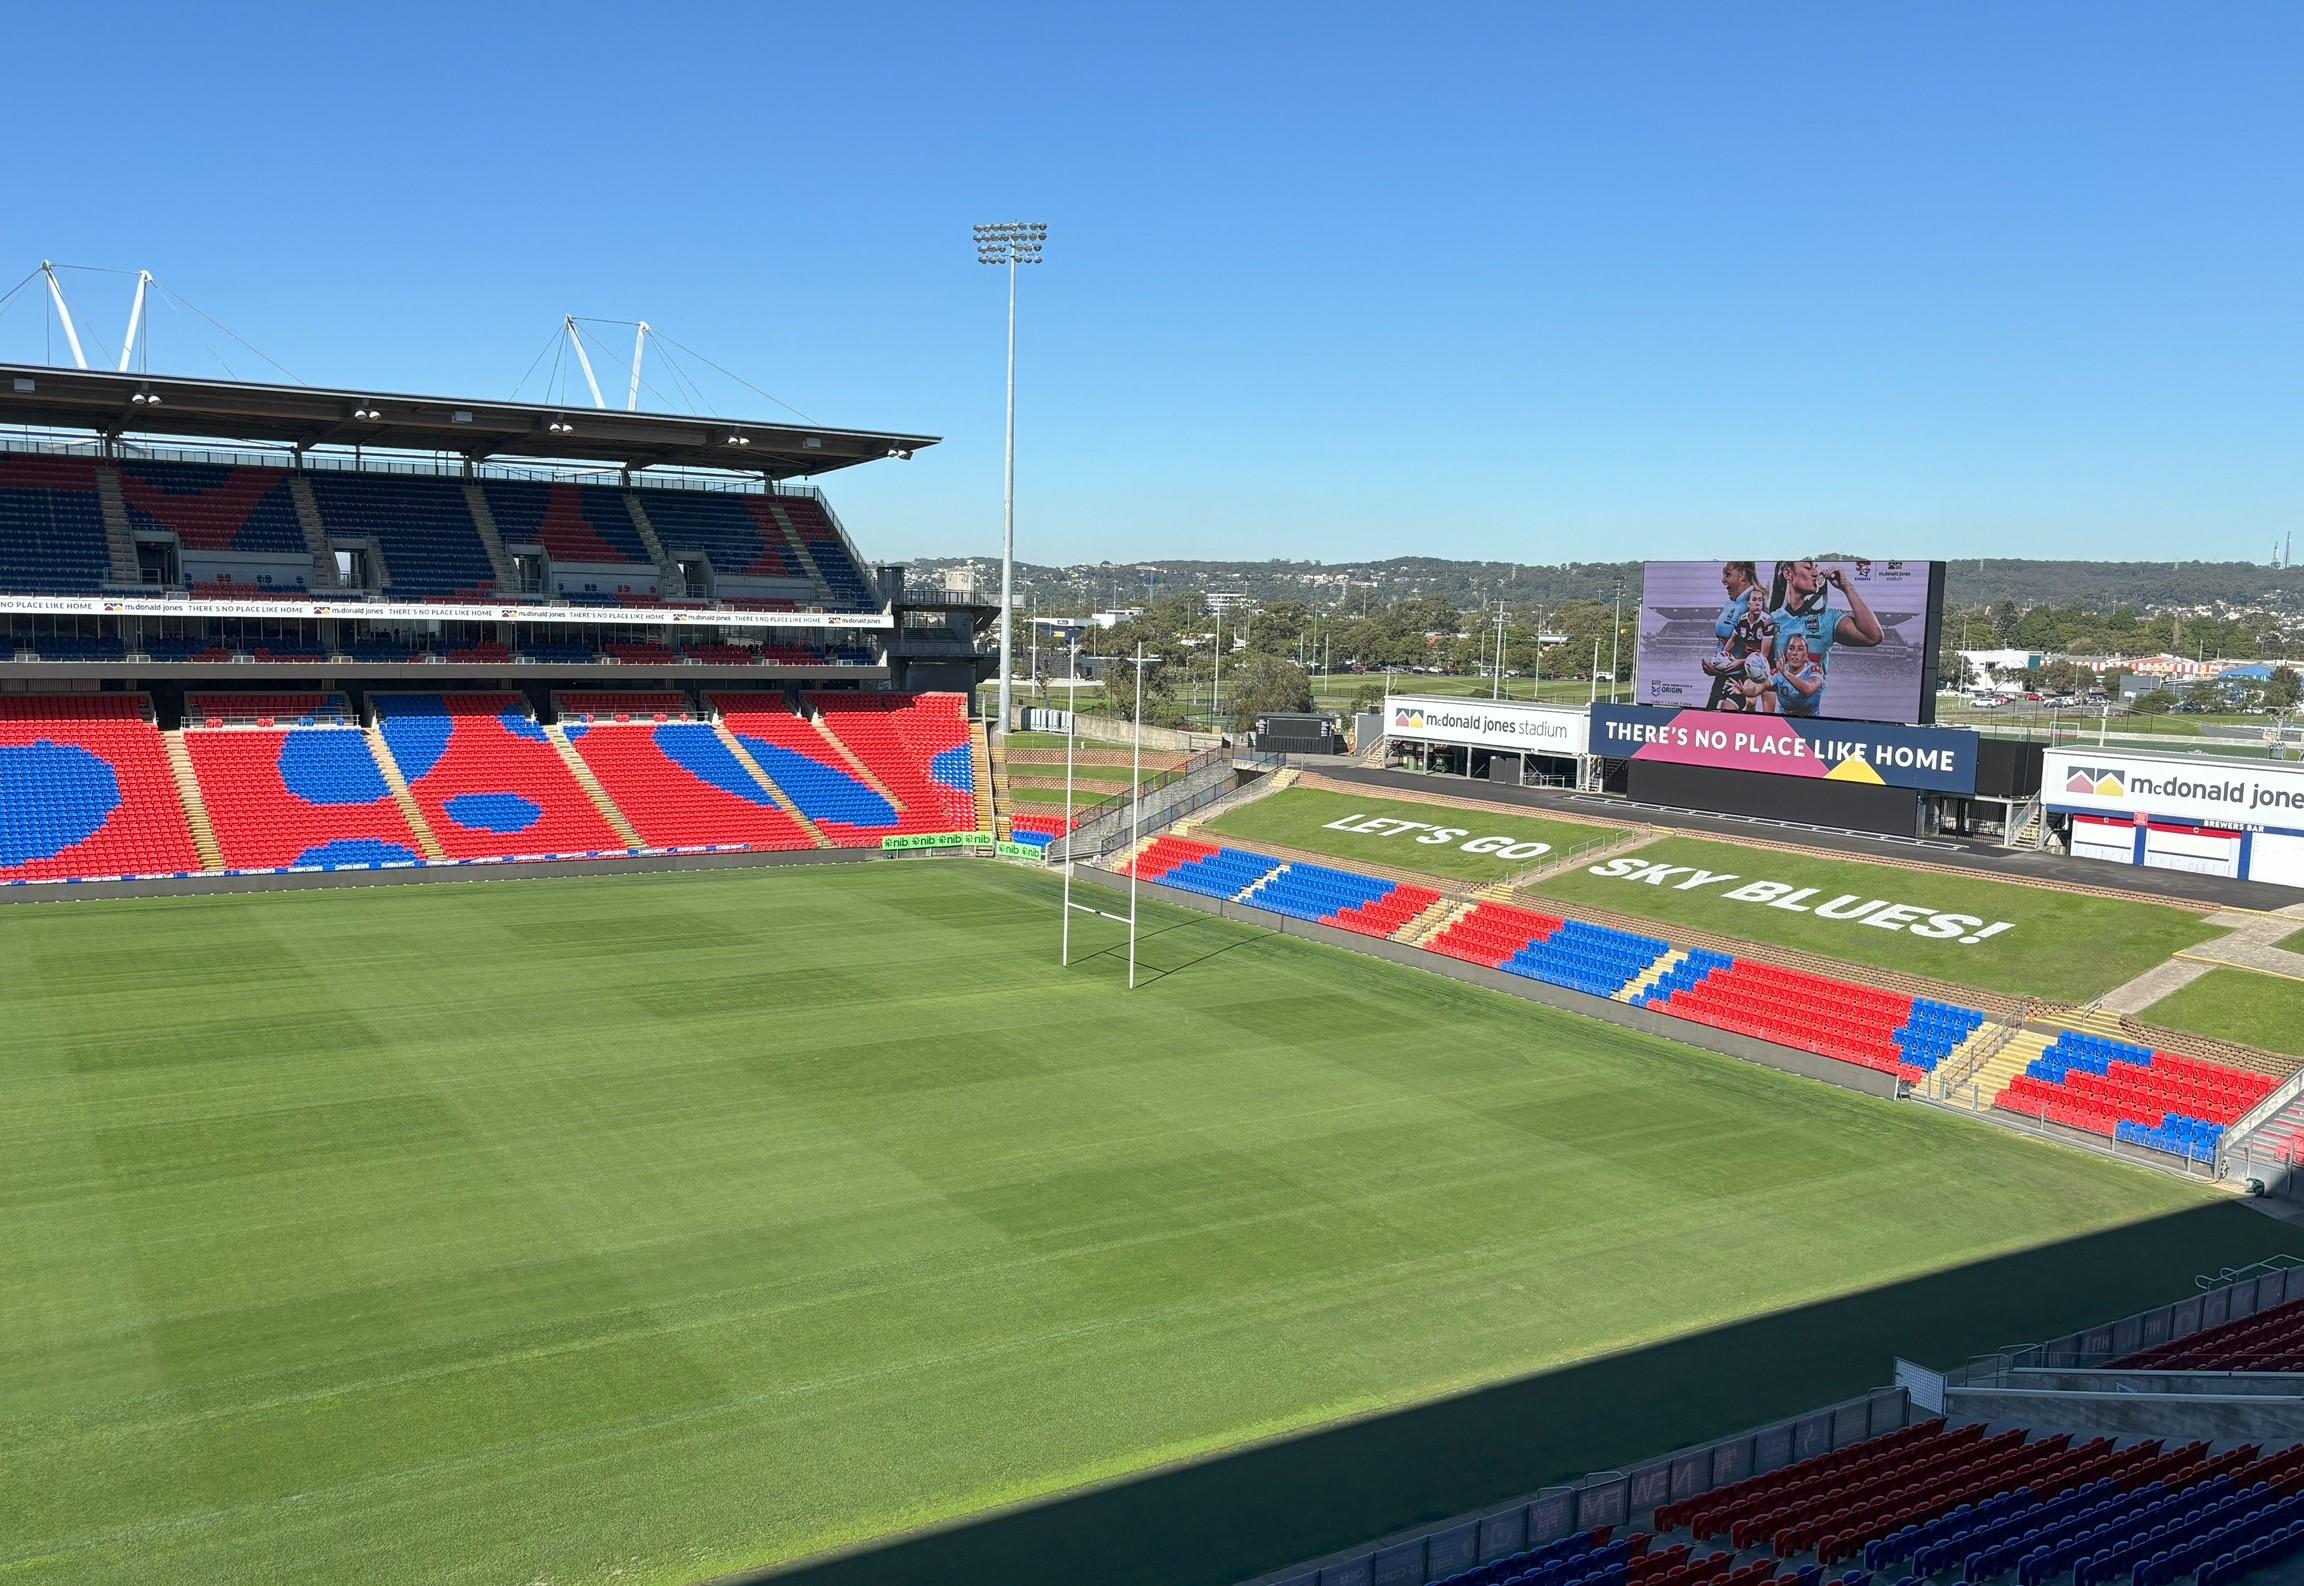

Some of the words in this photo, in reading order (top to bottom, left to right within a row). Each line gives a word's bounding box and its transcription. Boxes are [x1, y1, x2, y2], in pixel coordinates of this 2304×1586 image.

[125, 603, 162, 611] mcdonald
[163, 605, 183, 613] jones
[519, 610, 548, 618] mcdonald
[714, 614, 731, 622] jones
[866, 617, 881, 625] jones
[1661, 686, 1683, 694] ORIGIN
[1426, 713, 1481, 730] mcdonald
[1482, 717, 1516, 734] jones
[1518, 720, 1568, 739] stadium
[1605, 721, 1688, 747] THERE'S
[1695, 728, 1727, 750] NO
[1734, 732, 1806, 758] PLACE
[1814, 739, 1867, 763] LIKE
[1875, 744, 1955, 772] HOME
[2131, 776, 2245, 804] mcdonald
[2204, 819, 2244, 831] BREWERS
[2246, 824, 2265, 833] BAR
[920, 836, 935, 845] nib
[946, 834, 962, 844] nib
[974, 834, 990, 843] nib
[1321, 814, 1469, 844] LET'S
[1460, 836, 1552, 859] GO
[893, 837, 908, 847] nib
[1005, 845, 1019, 855] nib
[1027, 847, 1040, 857] nib
[1589, 858, 1739, 890] SKY
[1721, 880, 2016, 944] BLUES!
